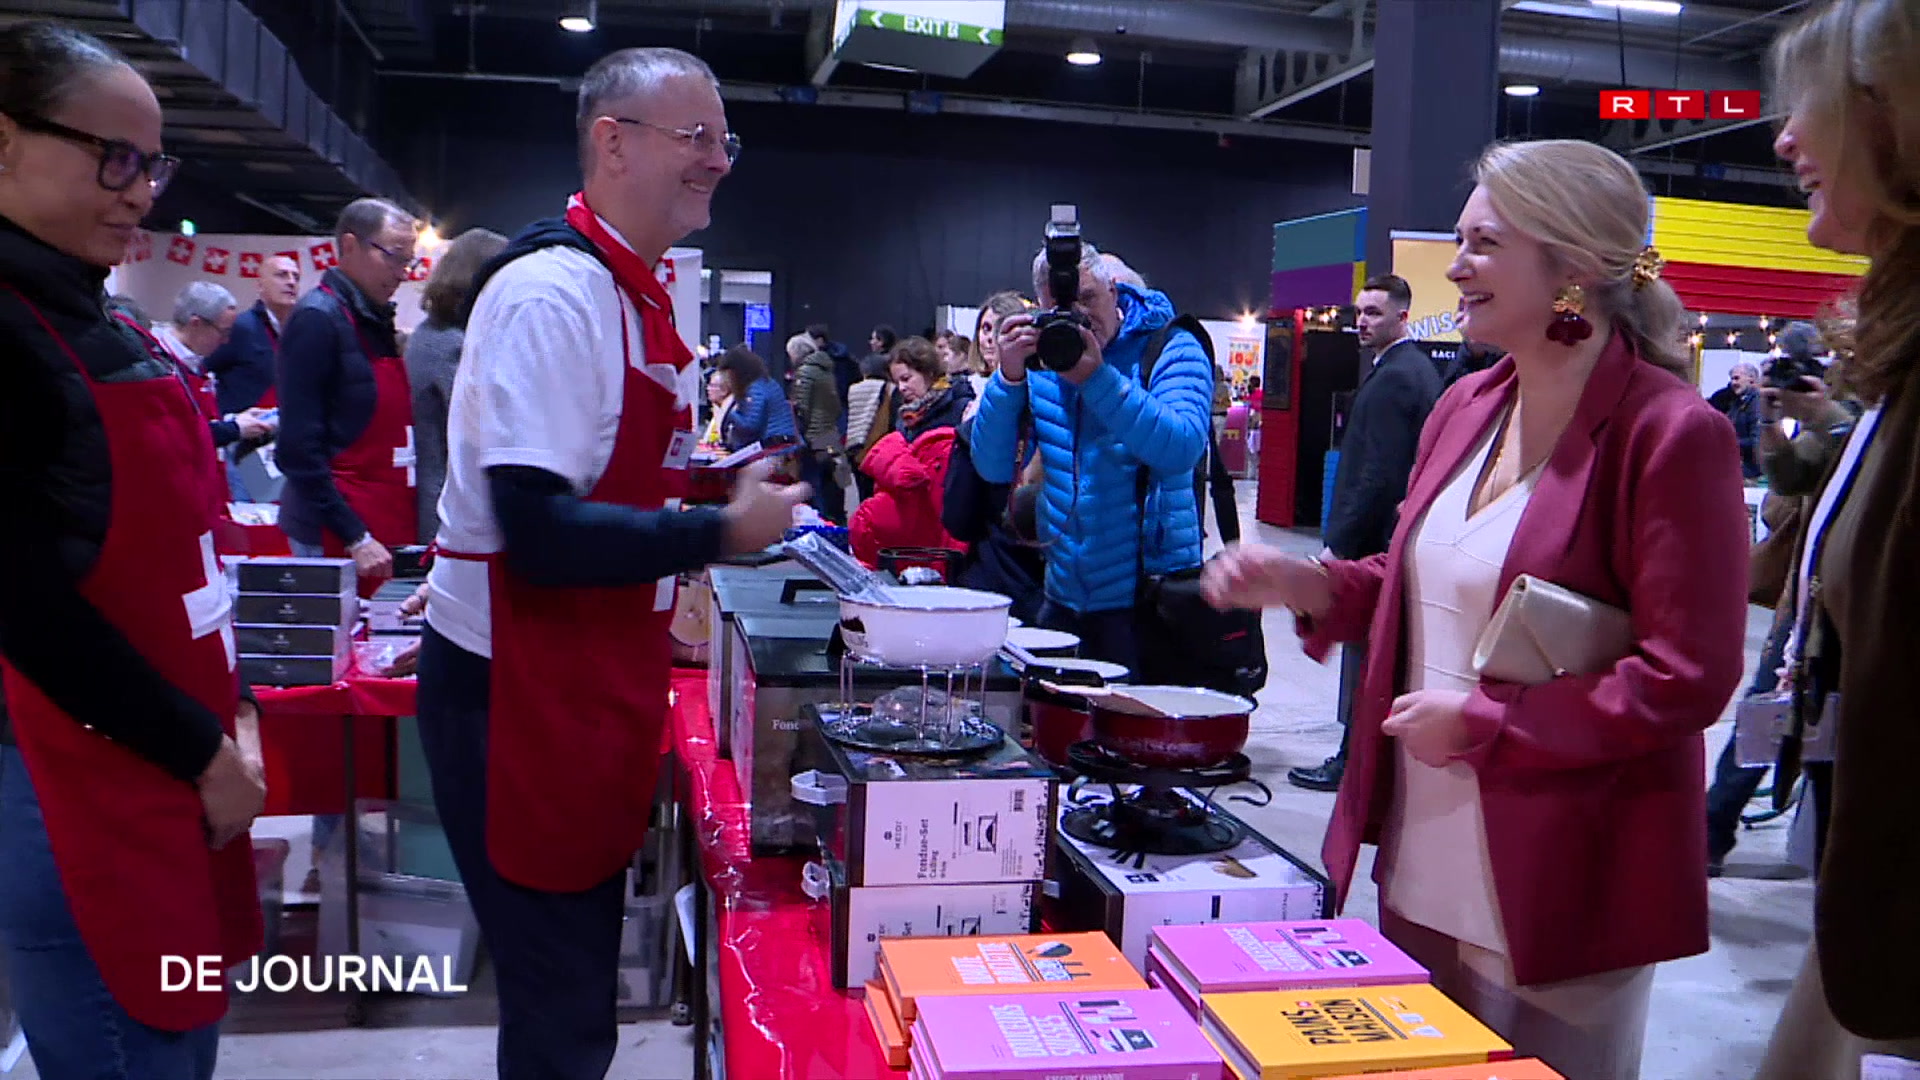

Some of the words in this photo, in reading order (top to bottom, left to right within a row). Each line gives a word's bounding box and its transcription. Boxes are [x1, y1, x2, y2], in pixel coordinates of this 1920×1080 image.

[903, 15, 945, 37] EXIT
[1280, 1007, 1352, 1046] PAINS
[1314, 997, 1396, 1043] MAISON
